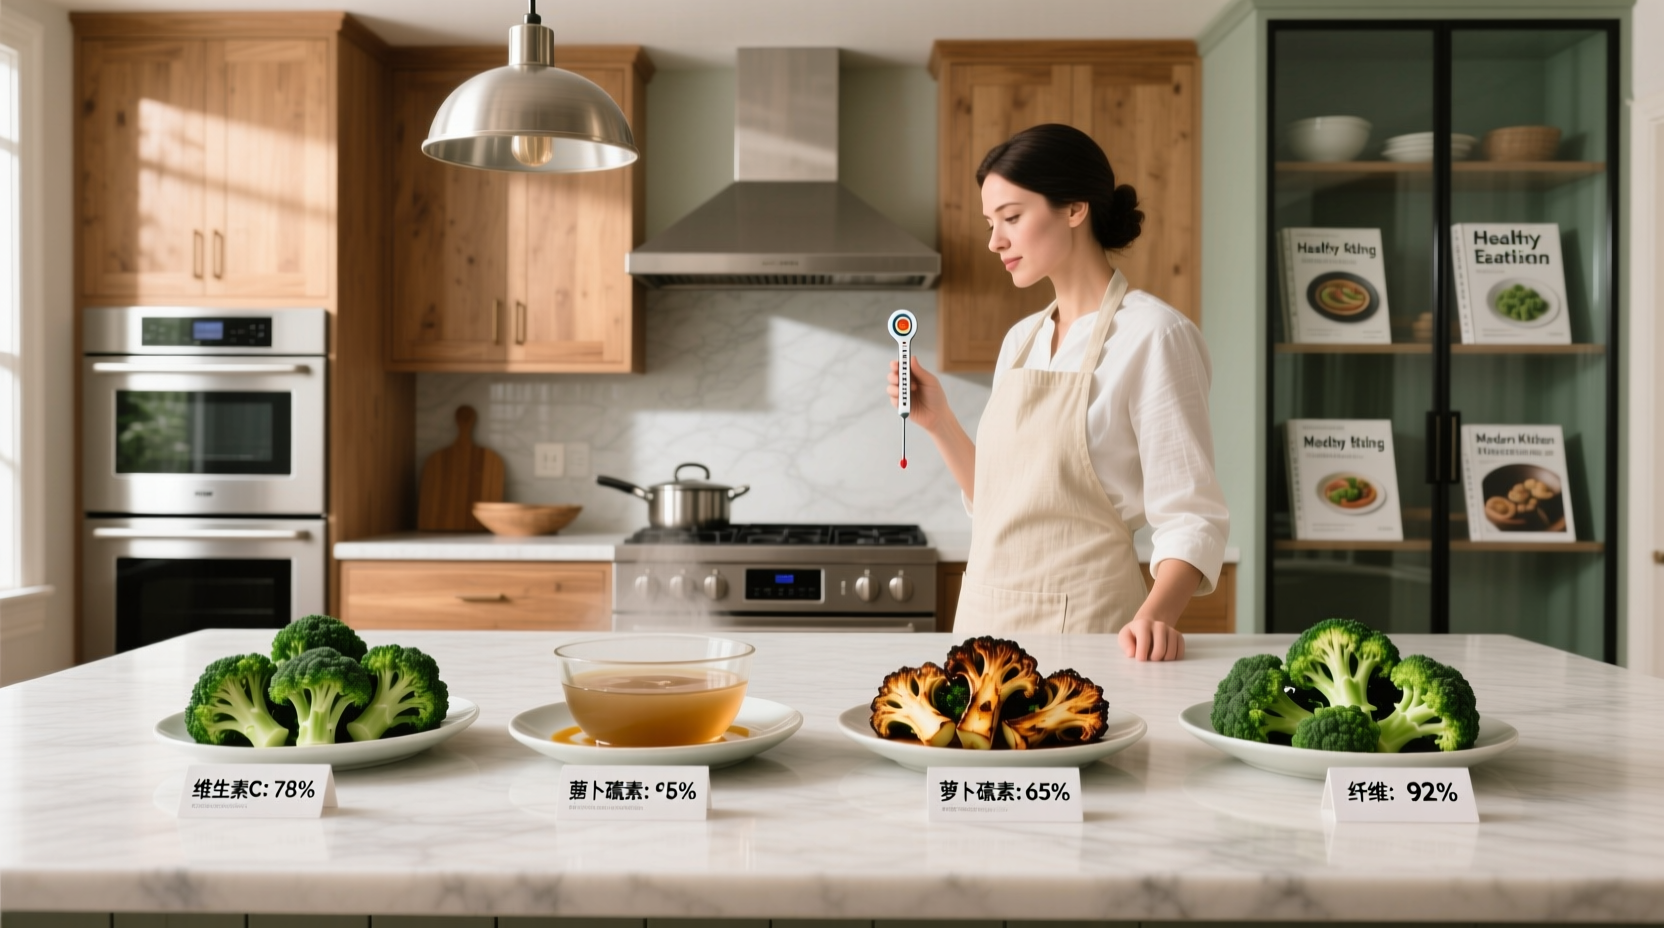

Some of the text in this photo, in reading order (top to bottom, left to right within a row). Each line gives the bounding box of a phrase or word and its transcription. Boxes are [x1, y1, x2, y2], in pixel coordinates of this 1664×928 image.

[191, 778, 316, 800] 维生素C: 78%
[1347, 780, 1459, 803] 纤维: 92%
